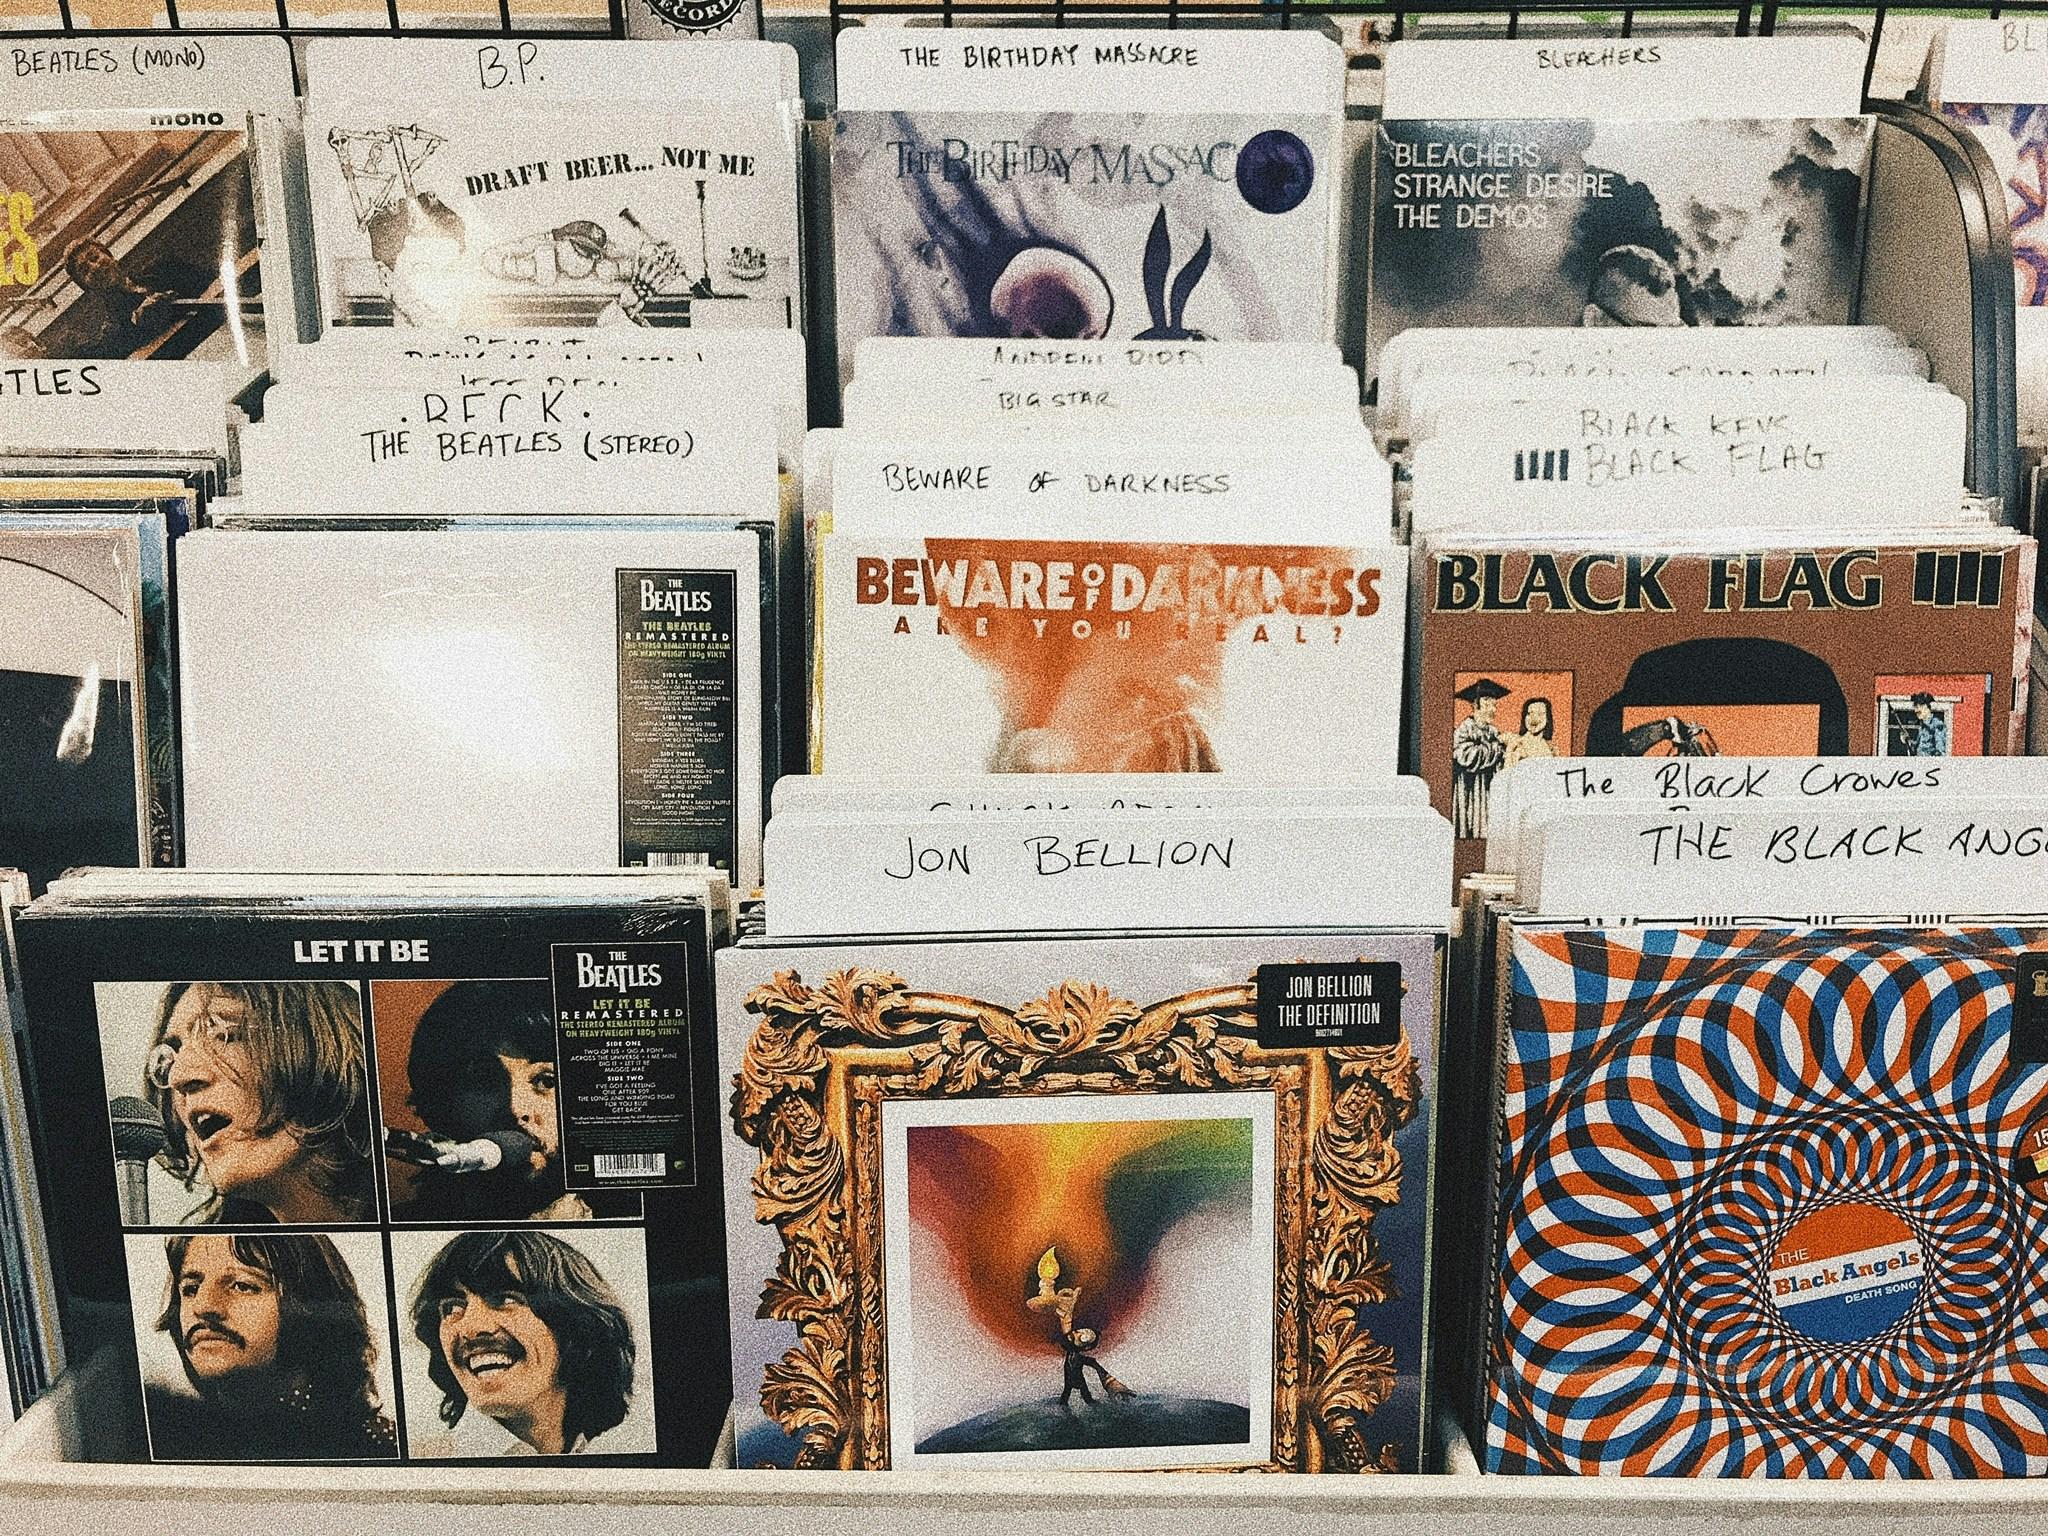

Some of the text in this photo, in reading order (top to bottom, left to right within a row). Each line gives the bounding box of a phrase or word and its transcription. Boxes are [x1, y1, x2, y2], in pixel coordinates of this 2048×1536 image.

[11, 40, 205, 77] BEATLES (MONO)
[478, 42, 545, 89] B.P.
[900, 42, 1198, 68] THE BIRTHDAY MASSACRE
[1537, 46, 1661, 69] BLEACHERS
[1088, 141, 1237, 186] MASSAC
[1393, 143, 1541, 168] BLEACHERS
[466, 147, 755, 196] DRAFT BEER... NOT ME
[1393, 173, 1614, 199] STRANGE DESIRE
[1393, 204, 1547, 229] THE DEMOS
[0, 366, 102, 395] TLES
[1000, 391, 1116, 409] BIG STAR
[361, 430, 694, 462] THE BEATLES (STEREO)
[1586, 441, 1828, 486] BLACK FLAG
[883, 464, 1230, 494] BEWARE OF DARKNESS
[667, 579, 683, 588] THE
[857, 557, 1076, 611] BEWARE
[1111, 563, 1381, 617] DARKNESS
[1432, 550, 1884, 614] BLACK FLAG
[640, 579, 712, 617] BEATLES
[625, 632, 729, 641] REMASTERED
[642, 621, 712, 631] THE BEATLES
[1033, 618, 1132, 640] YOU
[1556, 762, 1940, 799] The Black Crowes
[1640, 822, 2048, 865] THE BLACK ANG
[884, 836, 1233, 879] JON BELLION
[294, 939, 430, 962] LET IT BE
[608, 951, 627, 961] THE
[576, 953, 662, 993] BEATLES
[1286, 975, 1372, 998] JON BELLION
[561, 1009, 683, 1019] REMASTERED
[593, 998, 651, 1010] LET IT BE
[1278, 1002, 1380, 1027] THE DEFINITION
[576, 1021, 604, 1029] STEREO
[606, 1019, 656, 1028] REMASTERED
[579, 1029, 633, 1038] HEAVYWEIGHT
[637, 1029, 656, 1037] 180g
[1777, 1248, 1808, 1265] THE
[1773, 1251, 1920, 1296] Black Angels
[1845, 1280, 1918, 1304] DEATH SONG
